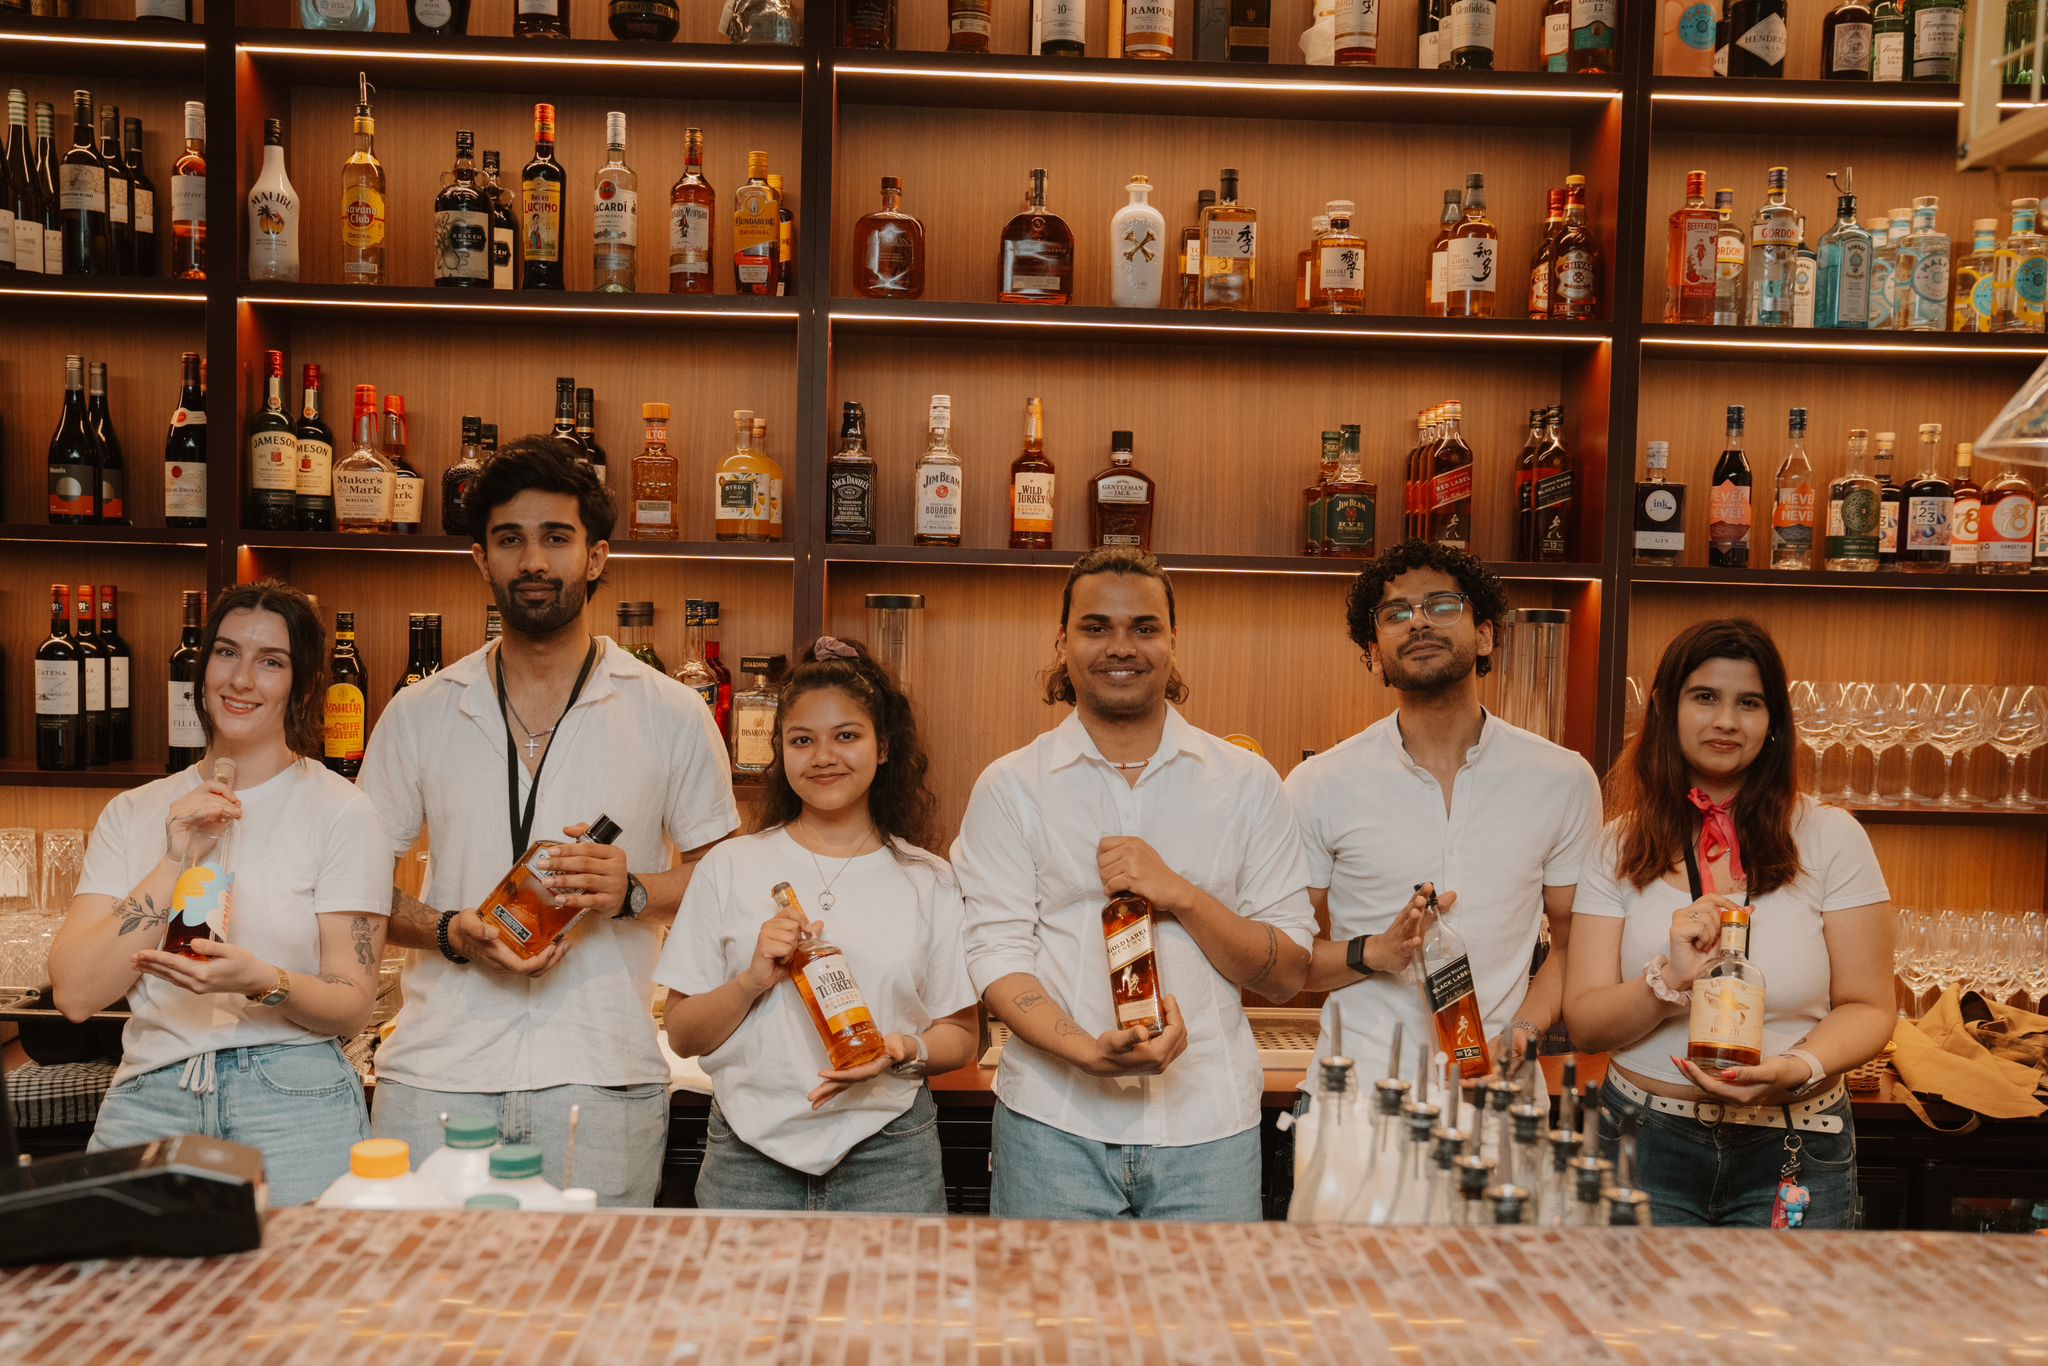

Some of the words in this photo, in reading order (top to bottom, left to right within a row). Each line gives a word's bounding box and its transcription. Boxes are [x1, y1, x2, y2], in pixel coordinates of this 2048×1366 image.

[1057, 4, 1067, 14] 10
[1130, 6, 1173, 15] RAMPUR
[1456, 2, 1491, 15] Glenfiddich
[251, 191, 294, 212] MALIBU
[349, 213, 370, 224] Club
[735, 216, 775, 226] BUNDABERG
[1211, 227, 1234, 236] TOKI
[1686, 221, 1718, 232] BEEFEATER
[452, 232, 482, 240] KRAKEN
[1847, 244, 1867, 252] BOMBAY
[1562, 261, 1593, 271] CHIVAS
[560, 401, 573, 410] CC
[578, 411, 590, 420] CC
[646, 429, 667, 440] ALTOS
[253, 435, 296, 449] JAMESON
[336, 475, 383, 485] Maker's
[832, 475, 847, 489] JACK
[846, 474, 870, 489] DANIEL'S
[923, 474, 939, 488] JIM
[940, 471, 960, 488] BEAM
[1436, 482, 1451, 493] RED
[1450, 475, 1472, 488] LABEL
[349, 485, 383, 495] Mark
[1021, 484, 1043, 495] WILD
[1114, 489, 1131, 497] JACK
[1537, 485, 1556, 496] BLACK
[1016, 492, 1047, 504] TURKEY
[1336, 500, 1351, 511] JIM
[1350, 498, 1366, 510] BEAM
[1653, 499, 1669, 509] ink
[925, 505, 957, 515] BOURBON
[1338, 520, 1365, 528] RYE
[1550, 541, 1558, 549] 12
[37, 667, 67, 676] CATENA
[741, 728, 773, 737] DISARONN
[1107, 940, 1126, 954] GOLD
[1125, 928, 1147, 944] LABEL
[818, 970, 846, 986] WILD
[1432, 980, 1453, 995] BLACK
[1452, 969, 1472, 983] LABEL
[815, 978, 855, 999] TURKEY
[1463, 1048, 1473, 1057] 12
